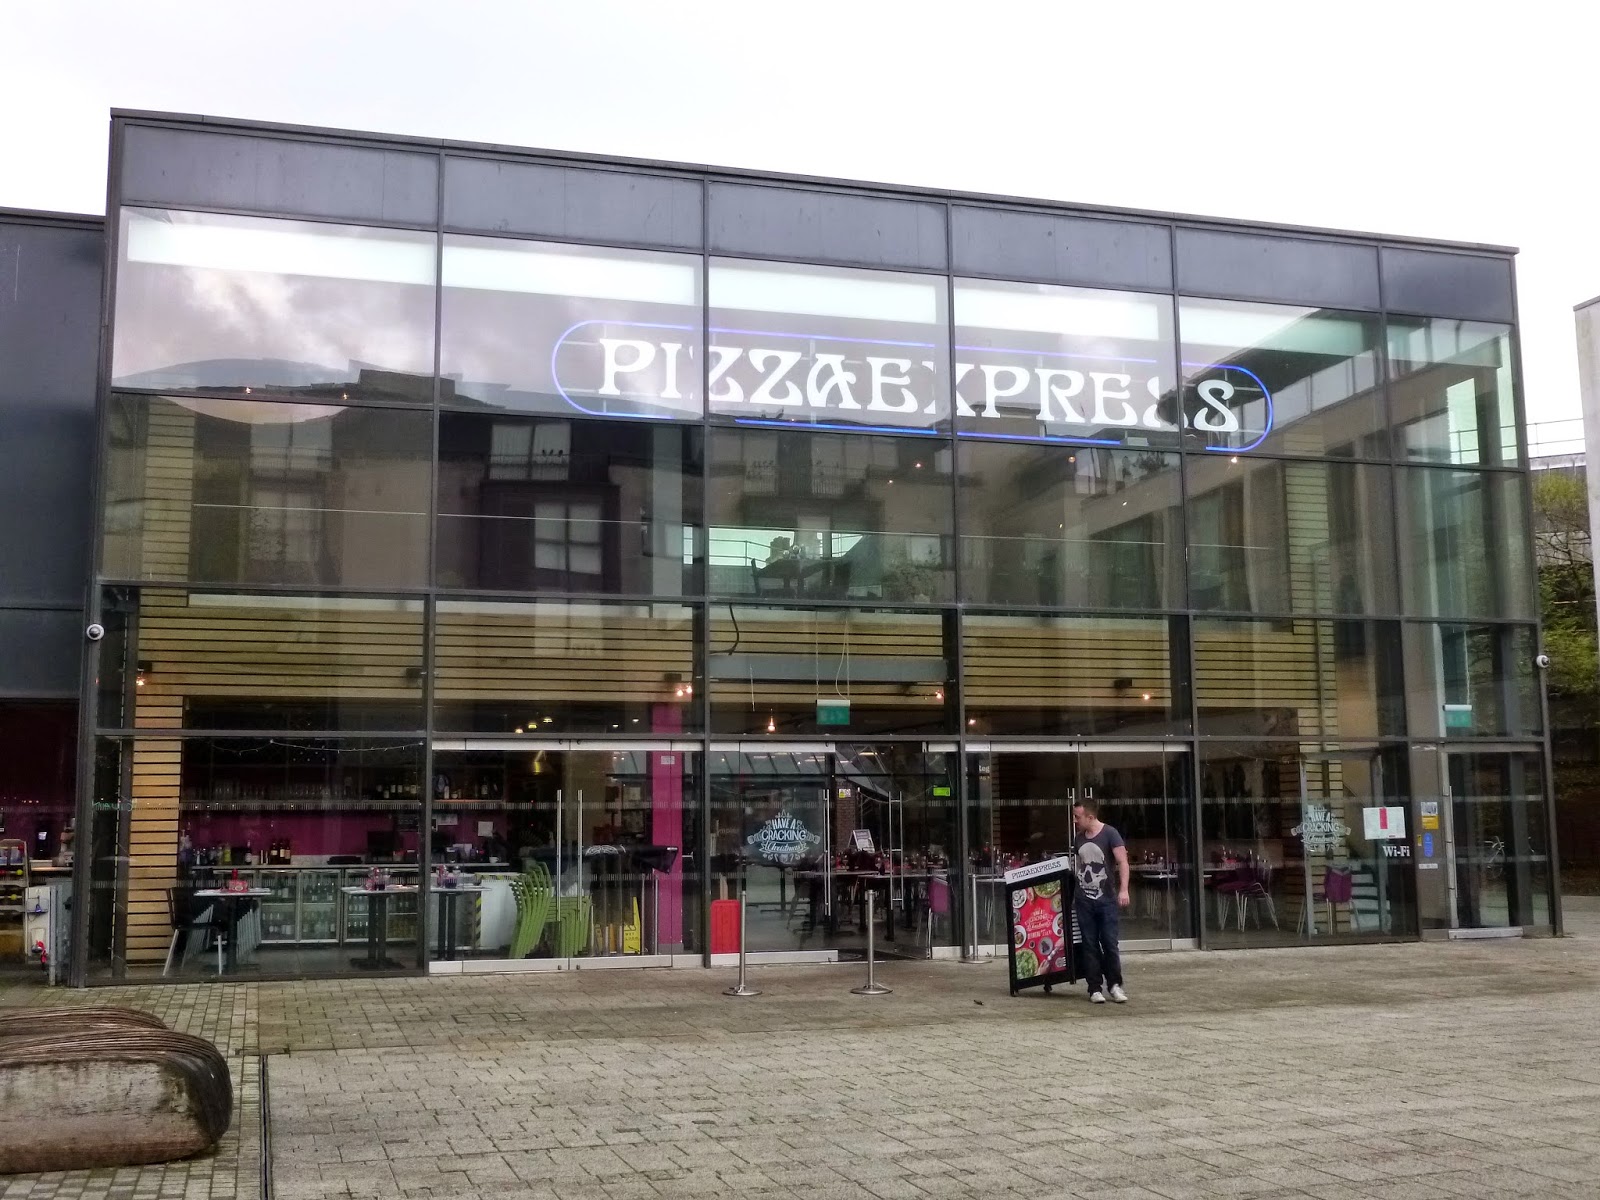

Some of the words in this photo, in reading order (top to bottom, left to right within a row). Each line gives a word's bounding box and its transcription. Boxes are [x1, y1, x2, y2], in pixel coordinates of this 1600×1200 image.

[772, 818, 790, 829] HAVE
[790, 818, 796, 829] A
[761, 830, 806, 840] CRACKING
[1383, 845, 1410, 857] Wi-Fi
[1011, 861, 1062, 880] PIZZAEXPRESS
